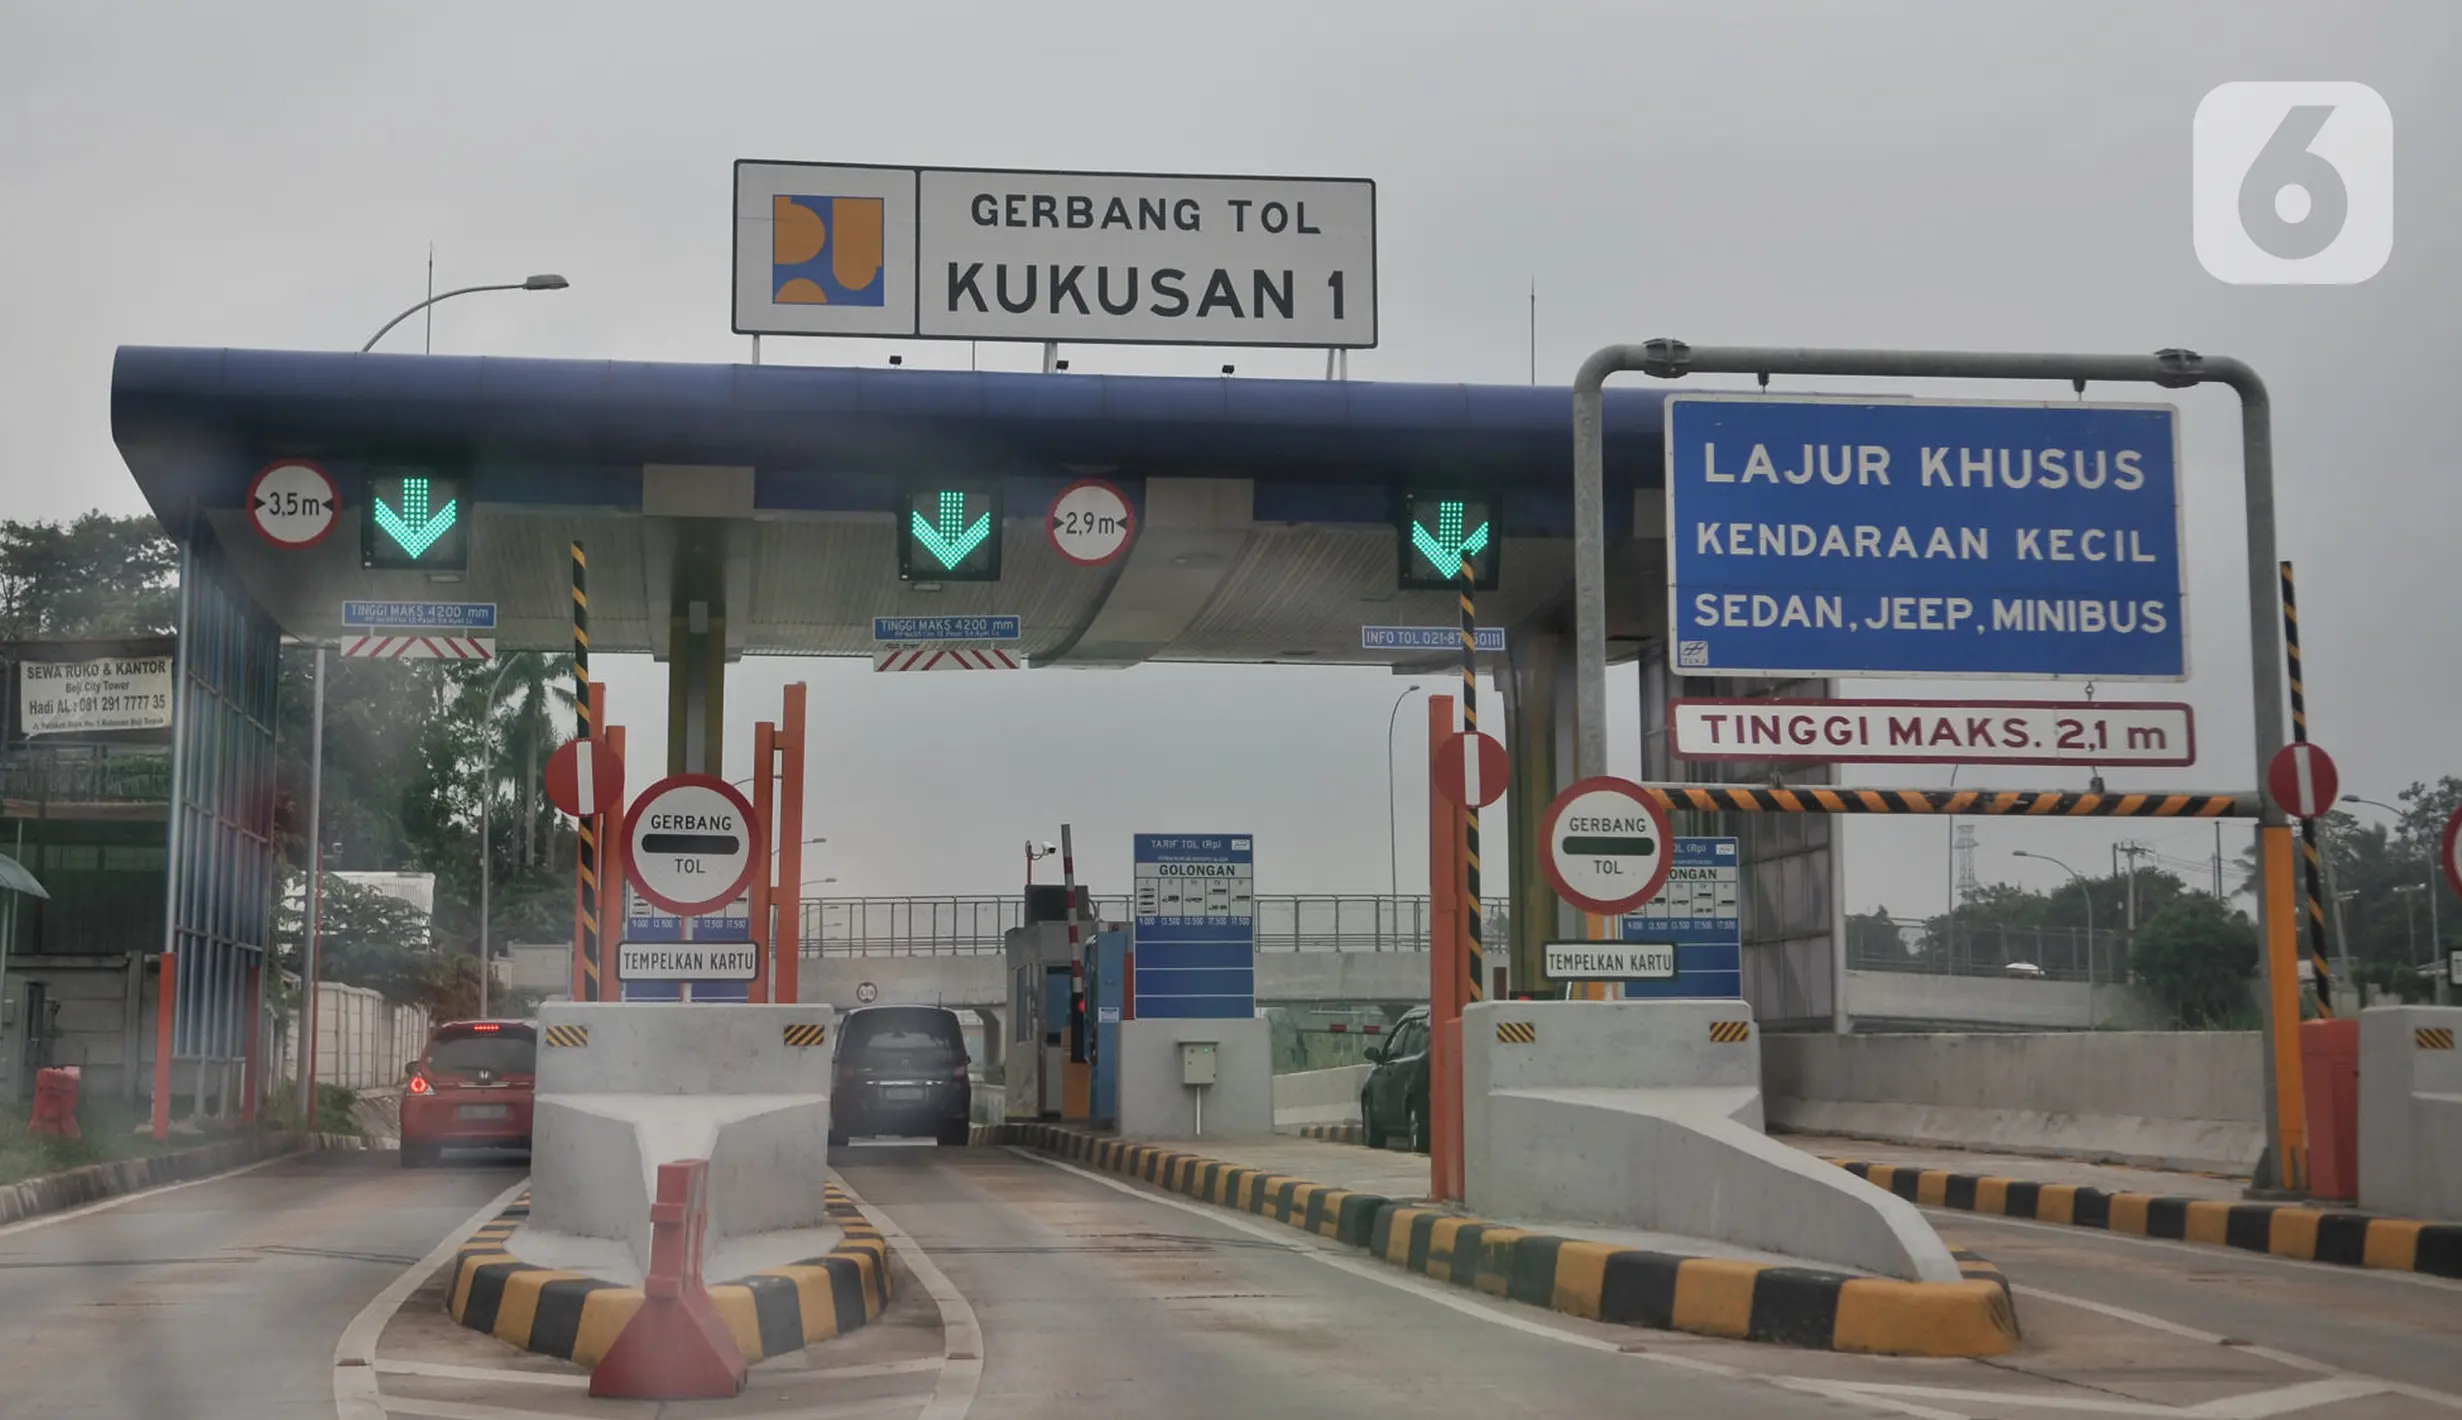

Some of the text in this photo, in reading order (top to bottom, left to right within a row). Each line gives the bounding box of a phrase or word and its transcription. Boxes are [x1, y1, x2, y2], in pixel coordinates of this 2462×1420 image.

[970, 193, 1321, 234] GERBANG TOL
[947, 261, 1345, 320] KUKUSAN 1
[1704, 442, 2145, 491] LAJUR KHUSUS
[1696, 521, 2157, 563] KENDARAAN KECIL
[351, 604, 489, 618] TINGGI MAKS 4200 mm
[1993, 599, 2168, 635] MINIBUS
[881, 618, 1014, 631] TINGGI MAKS 4200 mm
[1366, 631, 1394, 645] INFO
[1399, 631, 1420, 645] TOL
[27, 661, 166, 680] SEWA RUKO & KANTOR
[84, 681, 100, 694] City
[103, 680, 131, 692] Tower
[29, 700, 54, 715] Hadi
[102, 696, 121, 711] 291
[124, 695, 150, 711] 7777
[152, 694, 166, 710] 35
[1700, 714, 2167, 753] TINGGI MAKS. 2,1 m
[650, 814, 733, 831] GERBANG
[1569, 817, 1647, 833] GERBANG
[1151, 839, 1179, 849] TARIF
[674, 858, 706, 874] TOL
[1159, 864, 1236, 876] GOLONGAN
[1593, 859, 1624, 875] TOL
[623, 952, 754, 971] TEMPELKAN KARTU
[1548, 953, 1672, 971] TEMPELKAN KARTU
